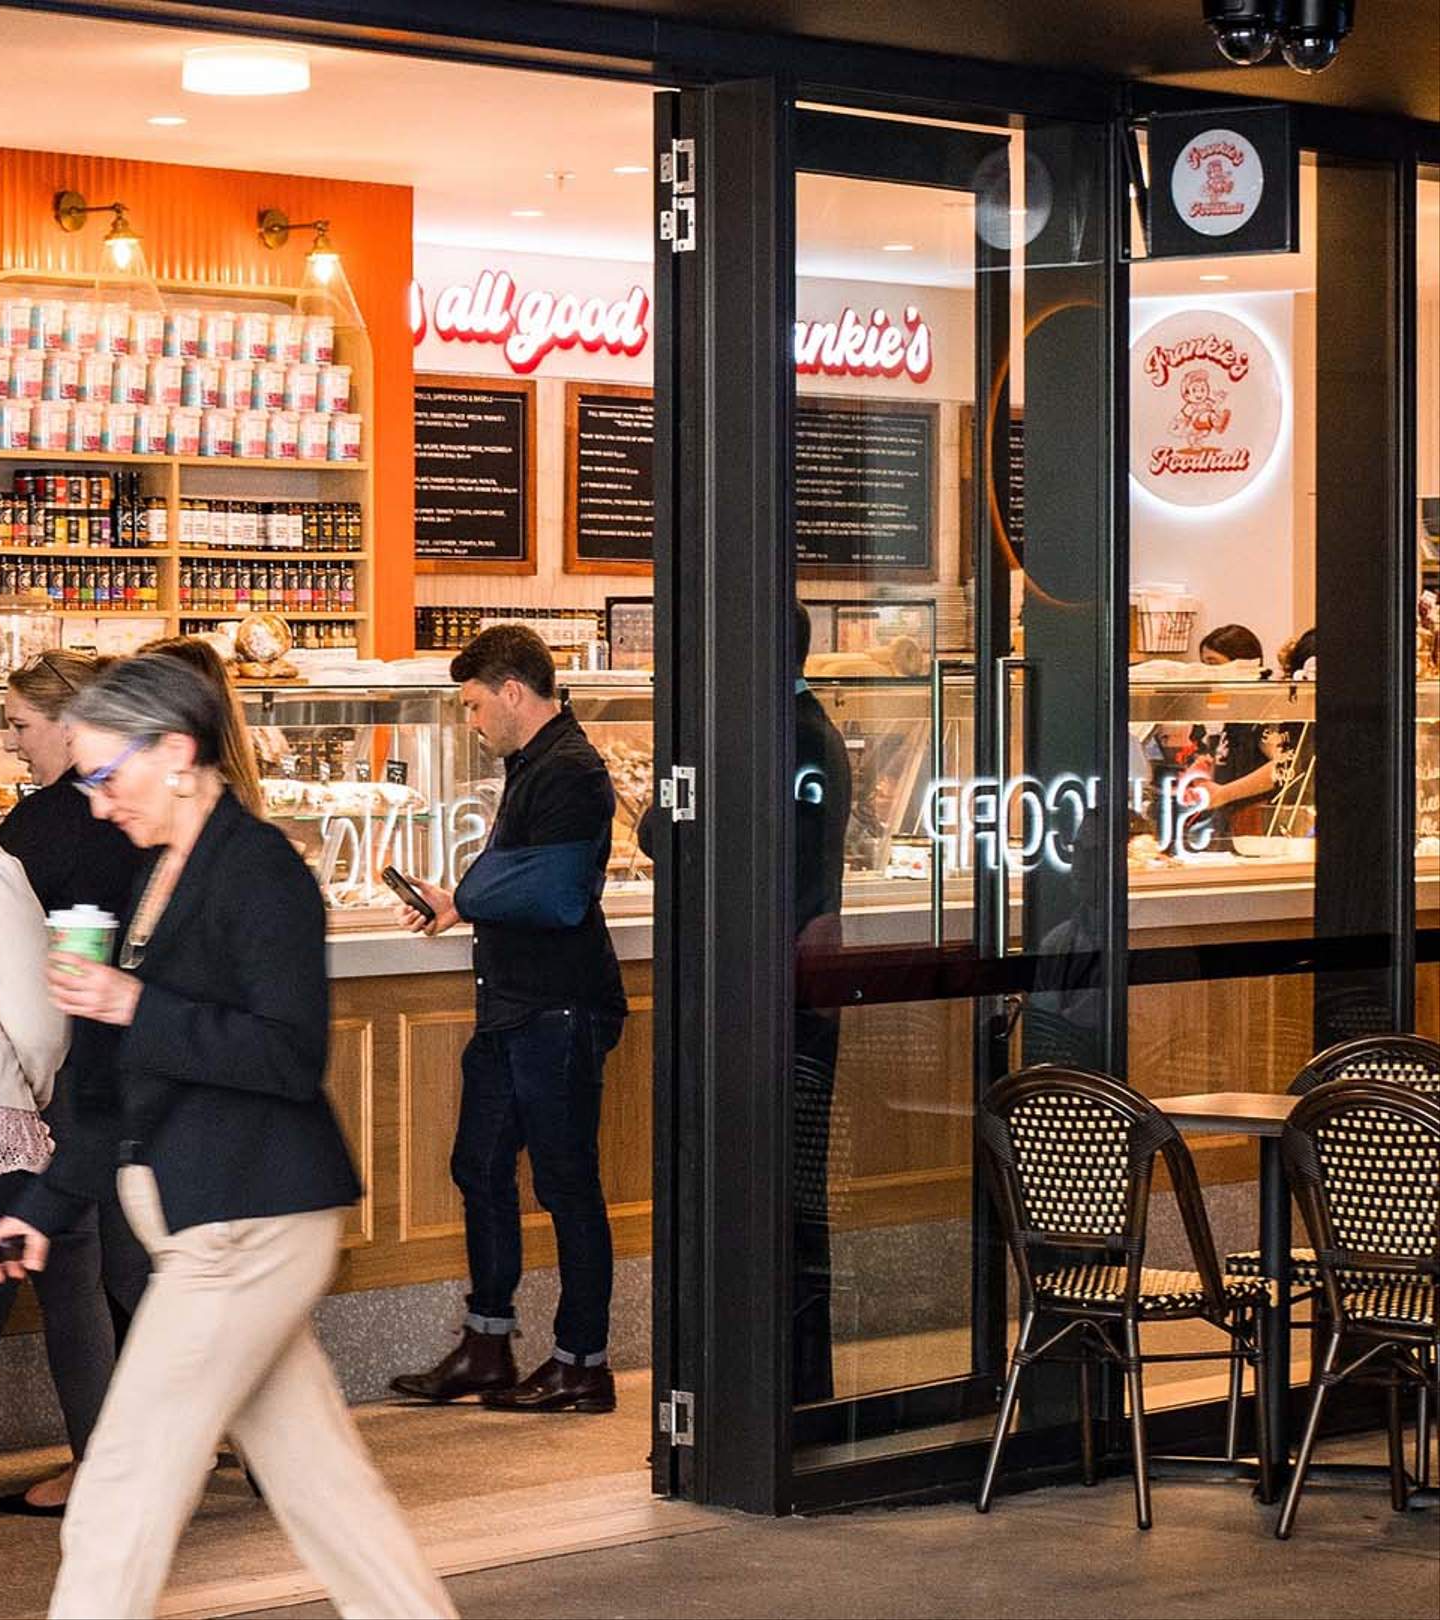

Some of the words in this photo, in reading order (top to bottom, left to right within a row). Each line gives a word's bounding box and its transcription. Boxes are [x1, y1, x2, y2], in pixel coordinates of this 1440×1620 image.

[434, 269, 516, 344] all
[504, 285, 649, 374] good
[1144, 334, 1249, 386] Frankie's
[1150, 445, 1250, 475] Foodhall
